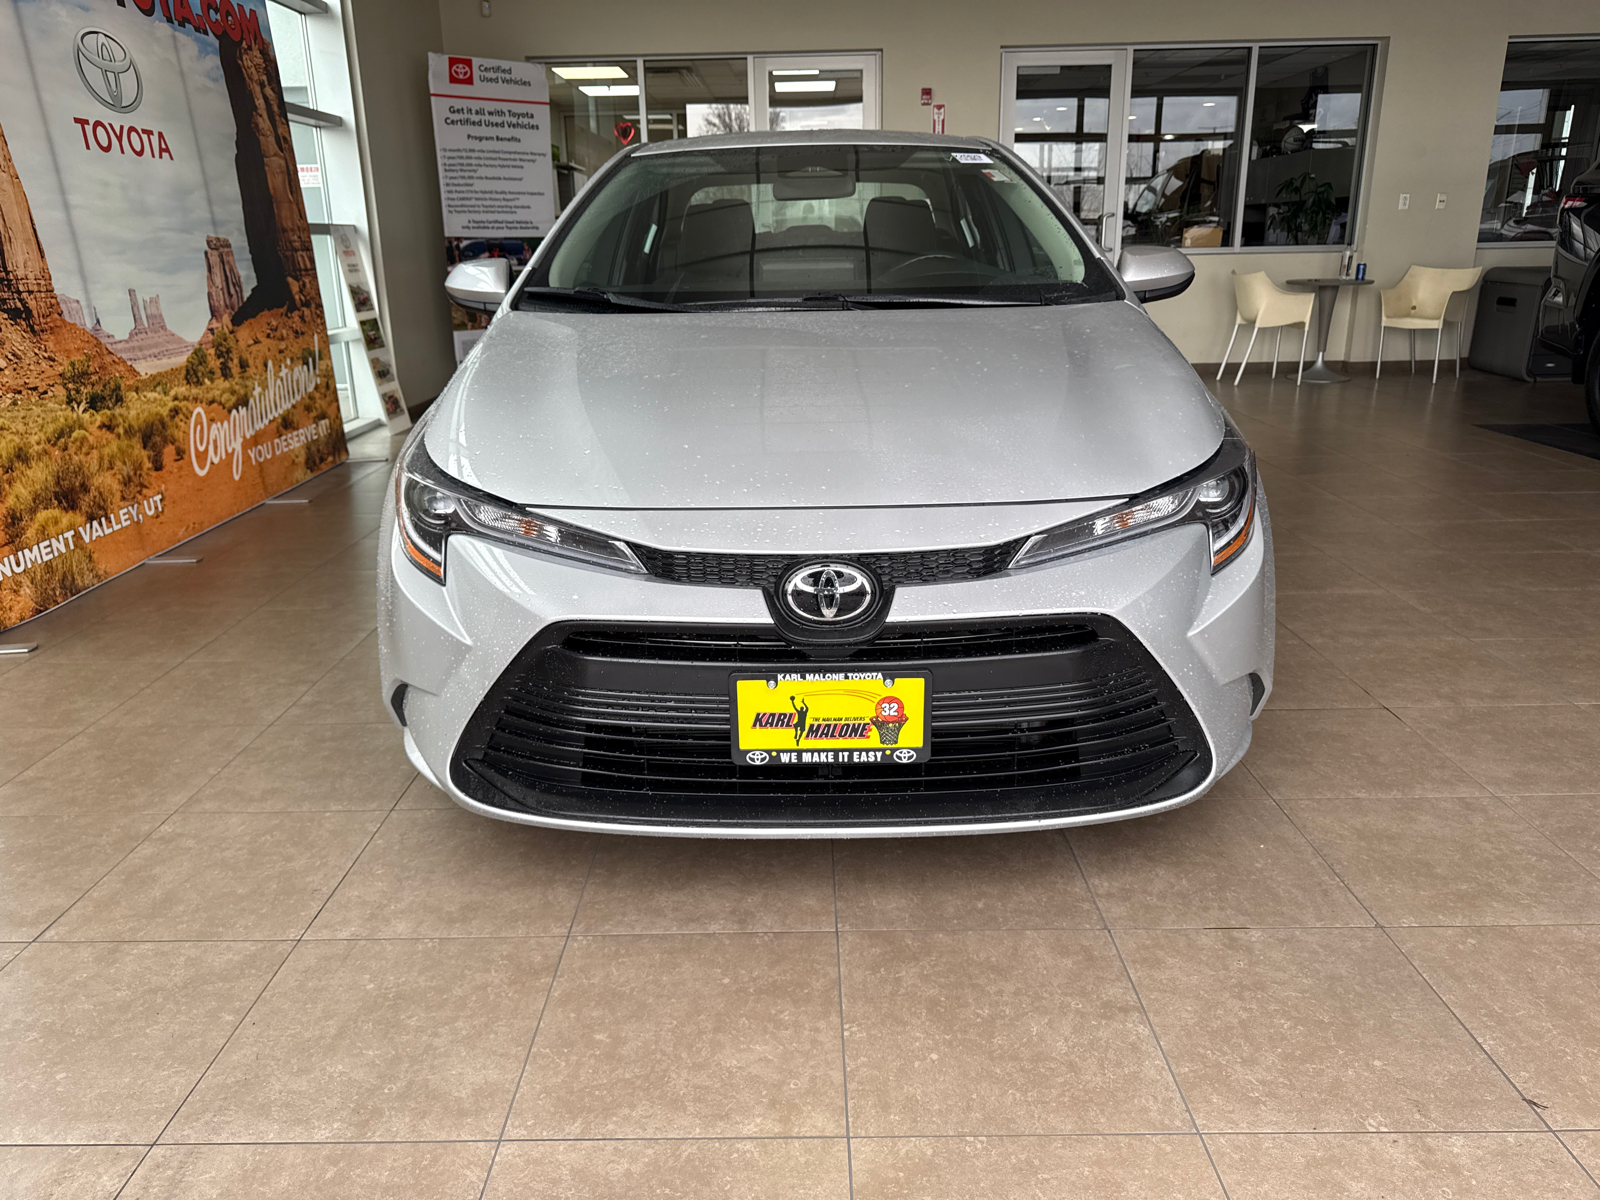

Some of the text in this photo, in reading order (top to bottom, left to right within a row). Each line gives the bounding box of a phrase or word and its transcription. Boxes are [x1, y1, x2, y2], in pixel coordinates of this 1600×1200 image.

[478, 64, 512, 75] Certified
[479, 75, 532, 87] Used Vehicles
[449, 106, 534, 120] Get it all with Toyota
[444, 116, 540, 130] Certified Used Vehicles
[72, 117, 174, 161] TOYOTA
[467, 134, 521, 143] Program Benefits
[189, 334, 320, 481] Congratulations!
[247, 418, 330, 466] YOU DESERVE IT!
[78, 504, 144, 544] VALLEY,
[144, 493, 164, 518] UT
[777, 673, 803, 682] KARL
[806, 673, 845, 681] MALONE
[881, 702, 899, 716] 32
[751, 712, 796, 729] KARL
[804, 722, 872, 740] MALONE
[780, 751, 883, 763] WE MAKE IT EASY
